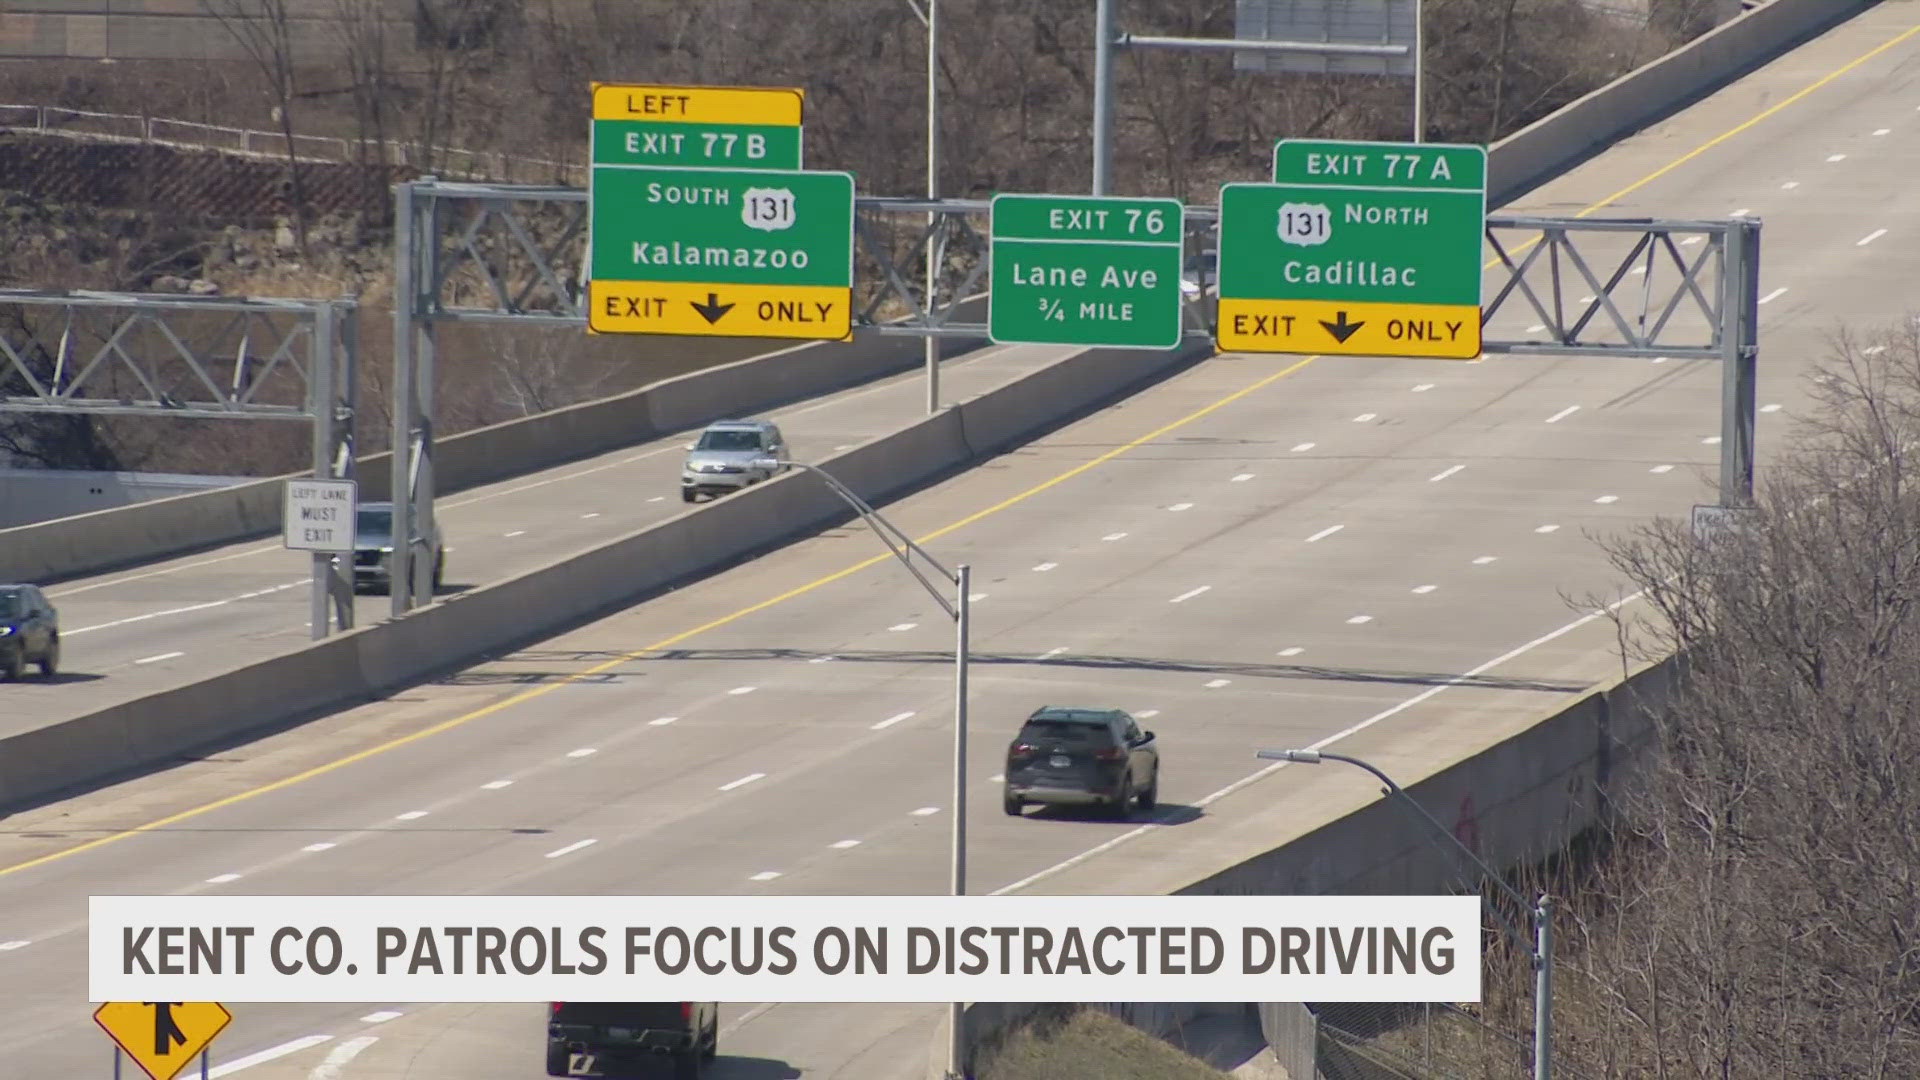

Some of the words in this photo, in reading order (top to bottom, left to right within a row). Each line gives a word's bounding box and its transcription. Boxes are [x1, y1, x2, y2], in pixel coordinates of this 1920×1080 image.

[628, 95, 690, 114] LEFT
[625, 132, 685, 154] EXIT
[702, 134, 738, 158] 77
[747, 136, 766, 159] B
[1307, 154, 1367, 176] EXIT
[1383, 155, 1420, 179] 77
[1430, 156, 1452, 180] A
[647, 183, 729, 206] SOUTH
[752, 198, 788, 222] 131
[1050, 209, 1109, 230] EXIT
[1125, 209, 1164, 234] 76
[1286, 213, 1323, 236] 131
[1345, 204, 1428, 225] NORTH
[633, 242, 808, 268] Kalamazoo
[1014, 264, 1087, 287] Lane
[1100, 266, 1158, 290] Ave
[1284, 261, 1416, 287] Cadillac
[606, 297, 668, 318] EXIT
[758, 301, 832, 322] ONLY
[1080, 303, 1133, 321] MILE
[1234, 315, 1296, 336] EXIT
[1387, 320, 1462, 342] ONLY
[301, 507, 337, 521] MUST
[304, 528, 333, 542] EXIT
